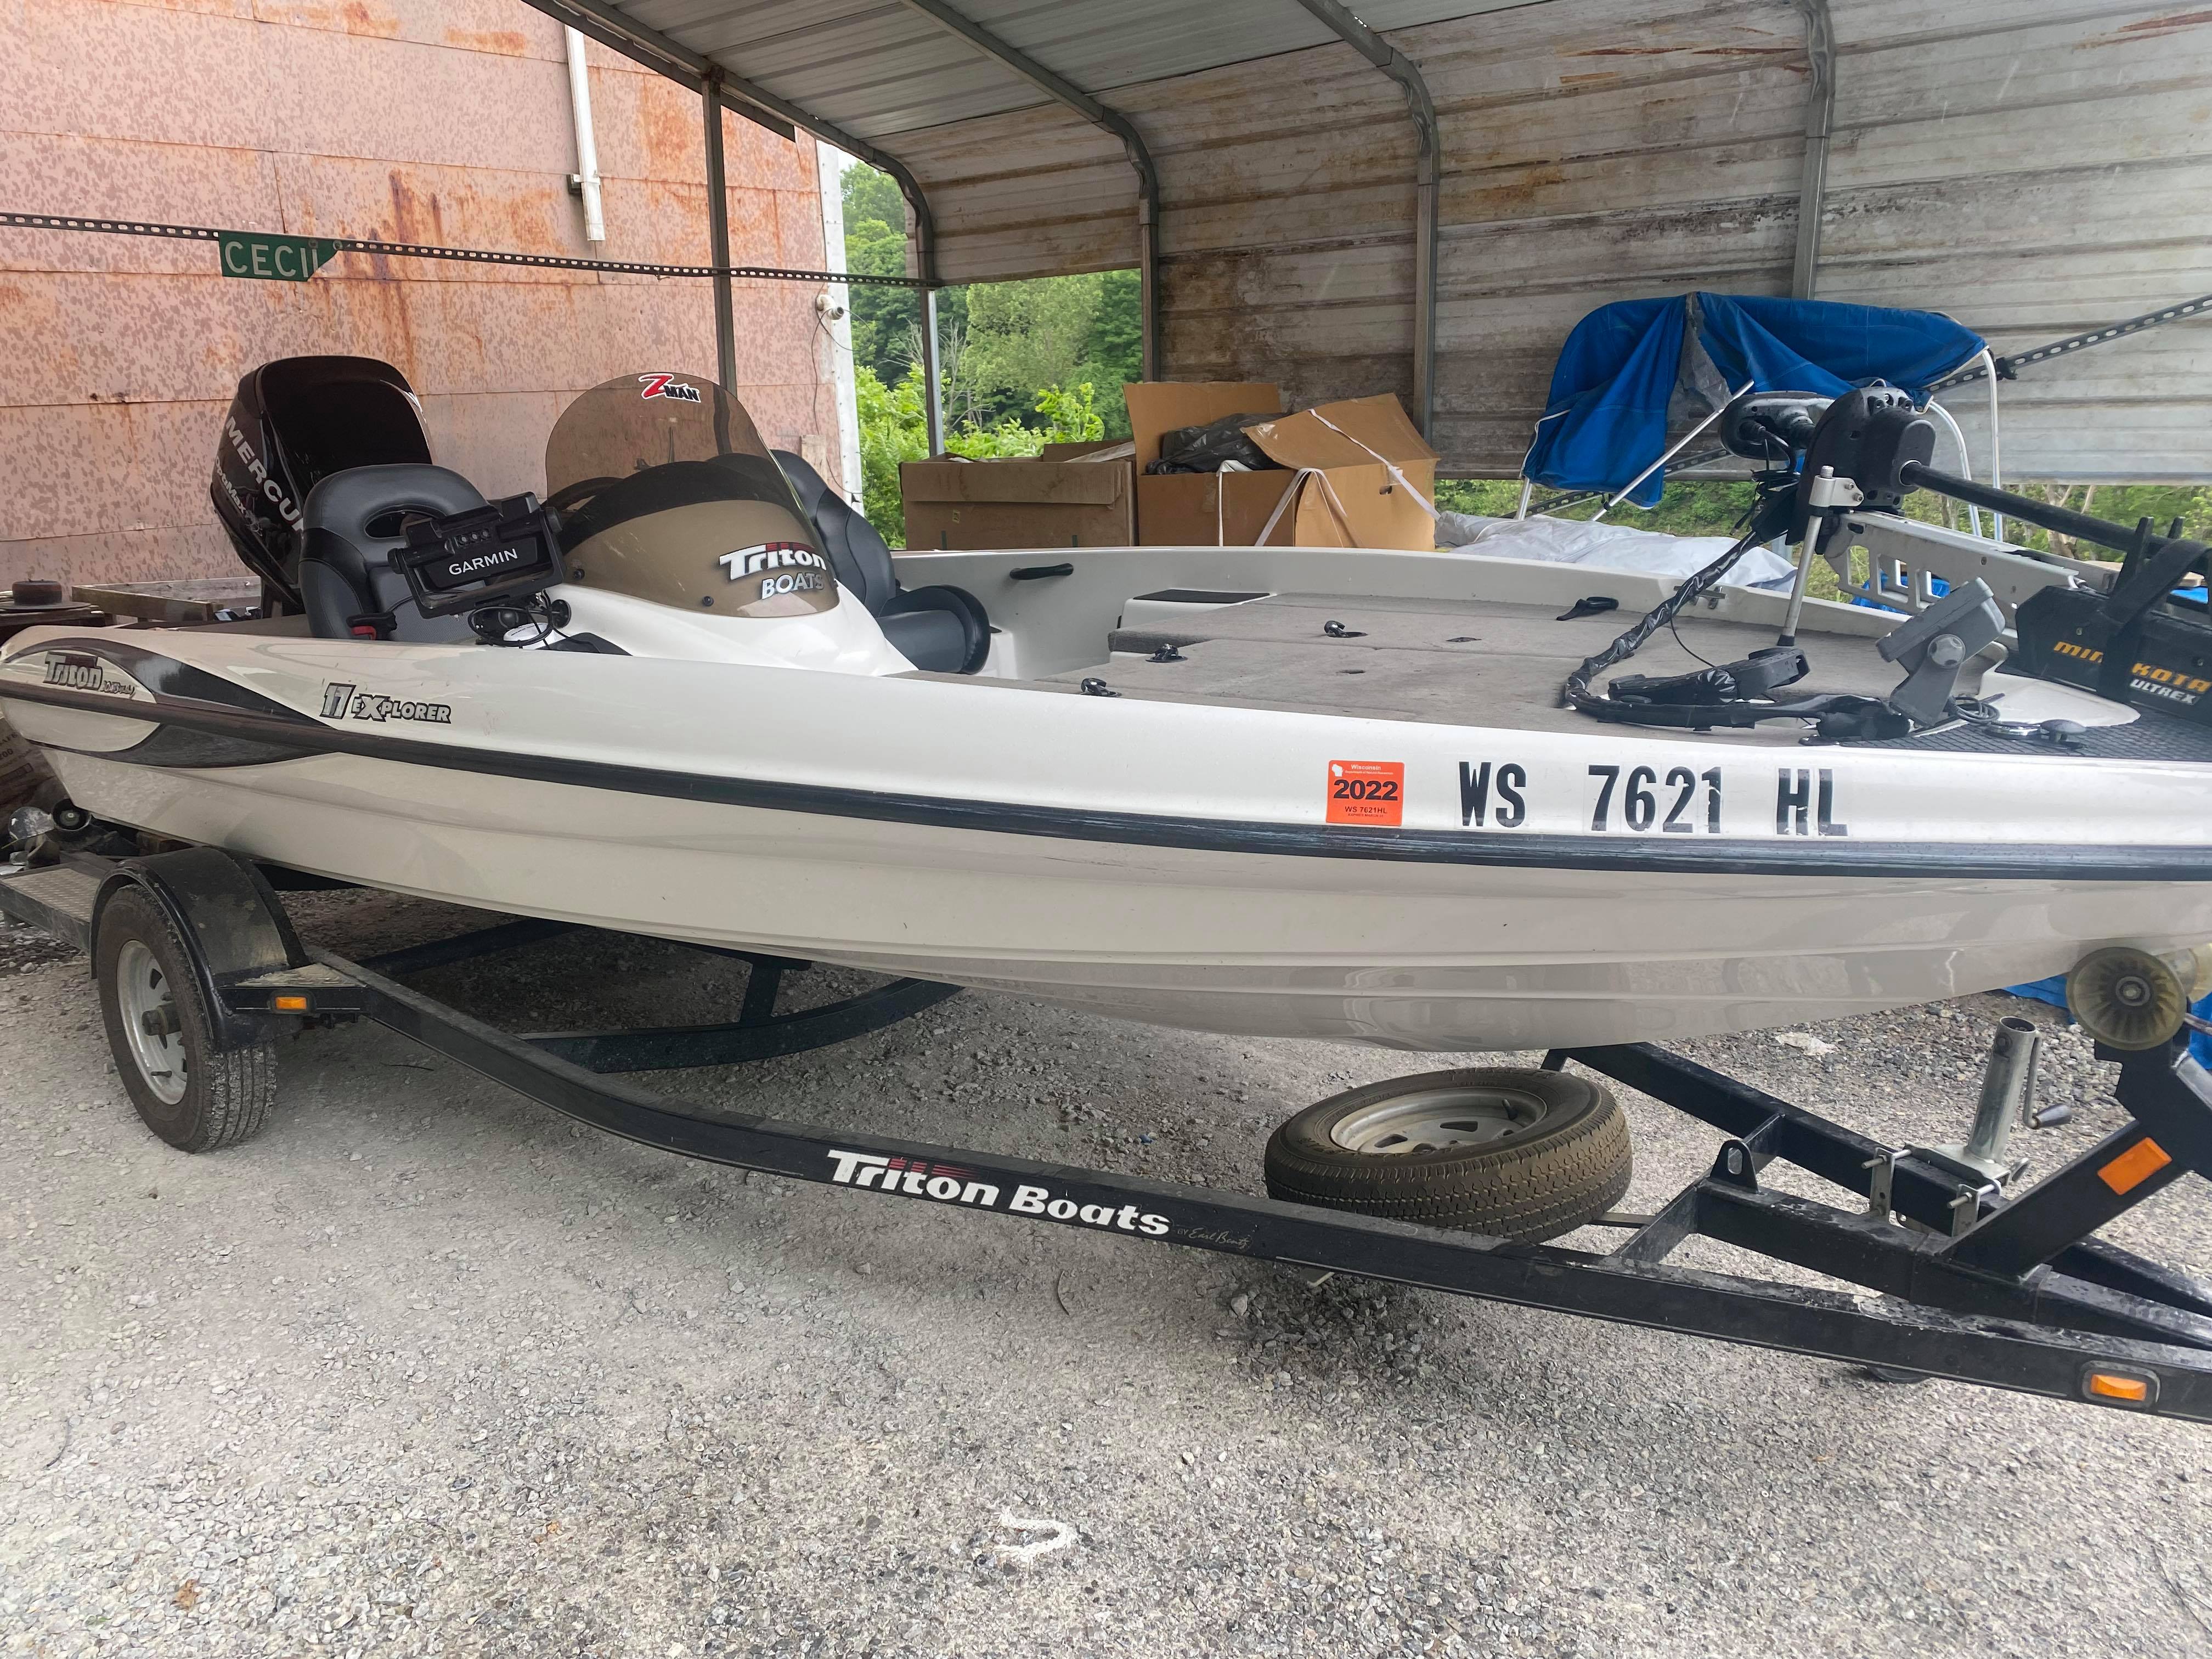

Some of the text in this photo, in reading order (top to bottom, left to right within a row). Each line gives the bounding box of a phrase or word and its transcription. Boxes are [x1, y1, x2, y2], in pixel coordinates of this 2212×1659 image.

[226, 416, 303, 531] MERCU
[449, 548, 517, 575] GARMIN
[718, 543, 827, 580] Triton
[761, 573, 824, 599] BOATS
[2130, 679, 2197, 704] ULTREX
[2131, 662, 2212, 693] KOTA
[319, 682, 451, 724] 17 EXPLORER
[1334, 779, 1398, 801] 2022
[1459, 761, 1848, 837] WS 7621 HL
[827, 1149, 1000, 1206] Triton
[1009, 1184, 1172, 1235] Boats
